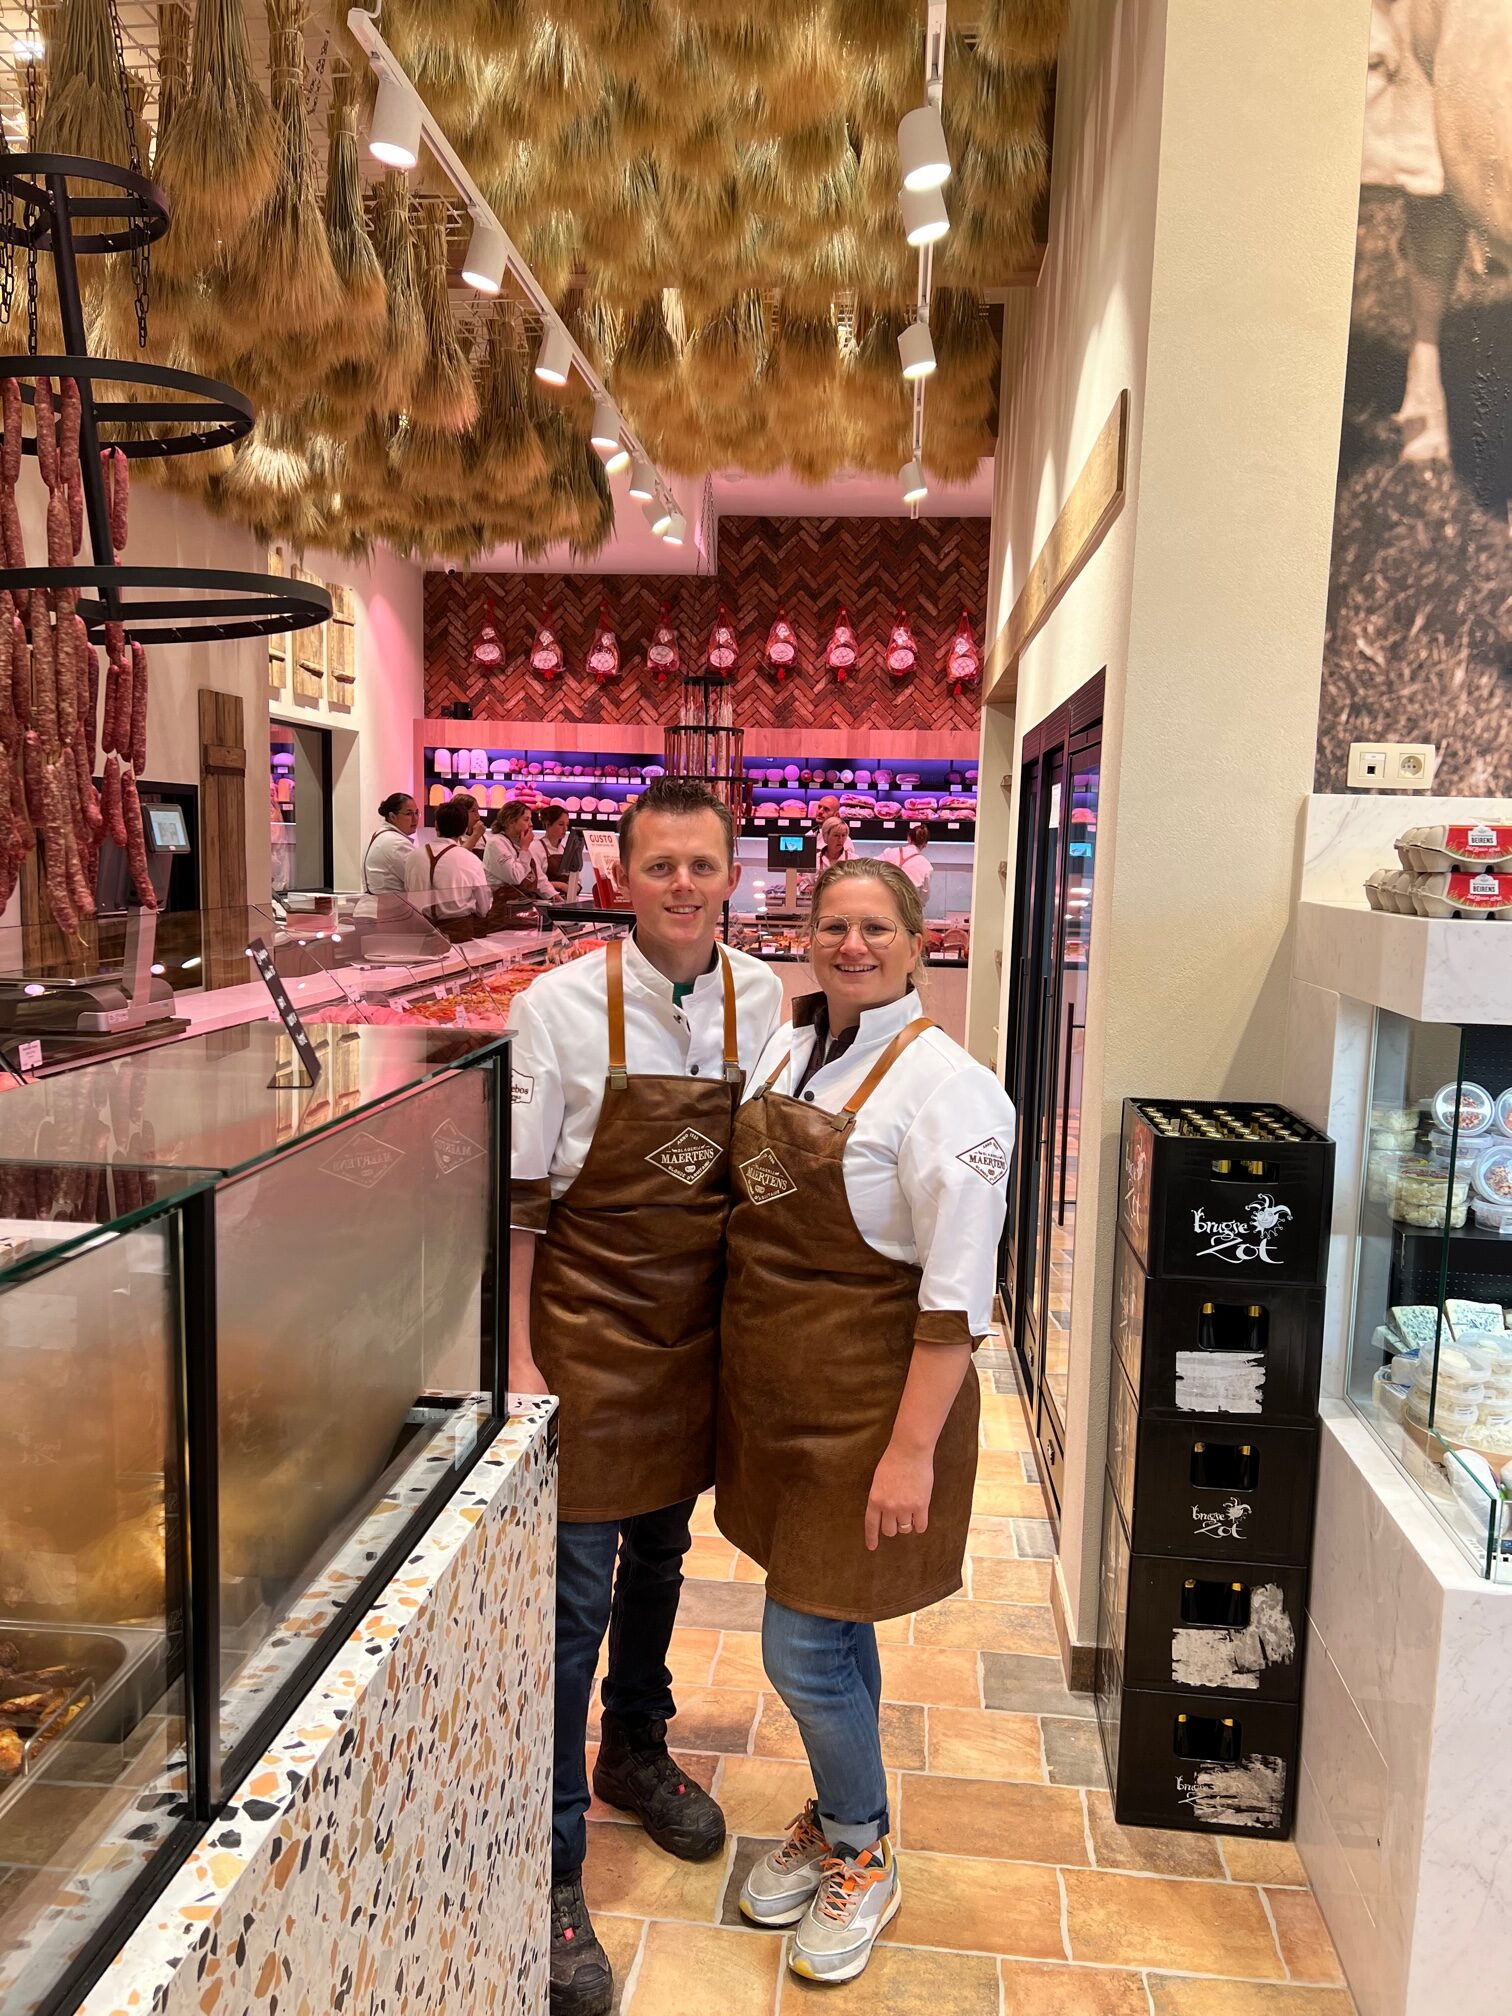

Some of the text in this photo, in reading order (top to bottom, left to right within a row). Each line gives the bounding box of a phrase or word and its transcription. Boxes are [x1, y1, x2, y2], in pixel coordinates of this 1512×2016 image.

[589, 834, 613, 844] GUSTO
[661, 1148, 714, 1164] MAERTENS
[1196, 1236, 1285, 1265] Zot
[1194, 1521, 1248, 1540] Zot
